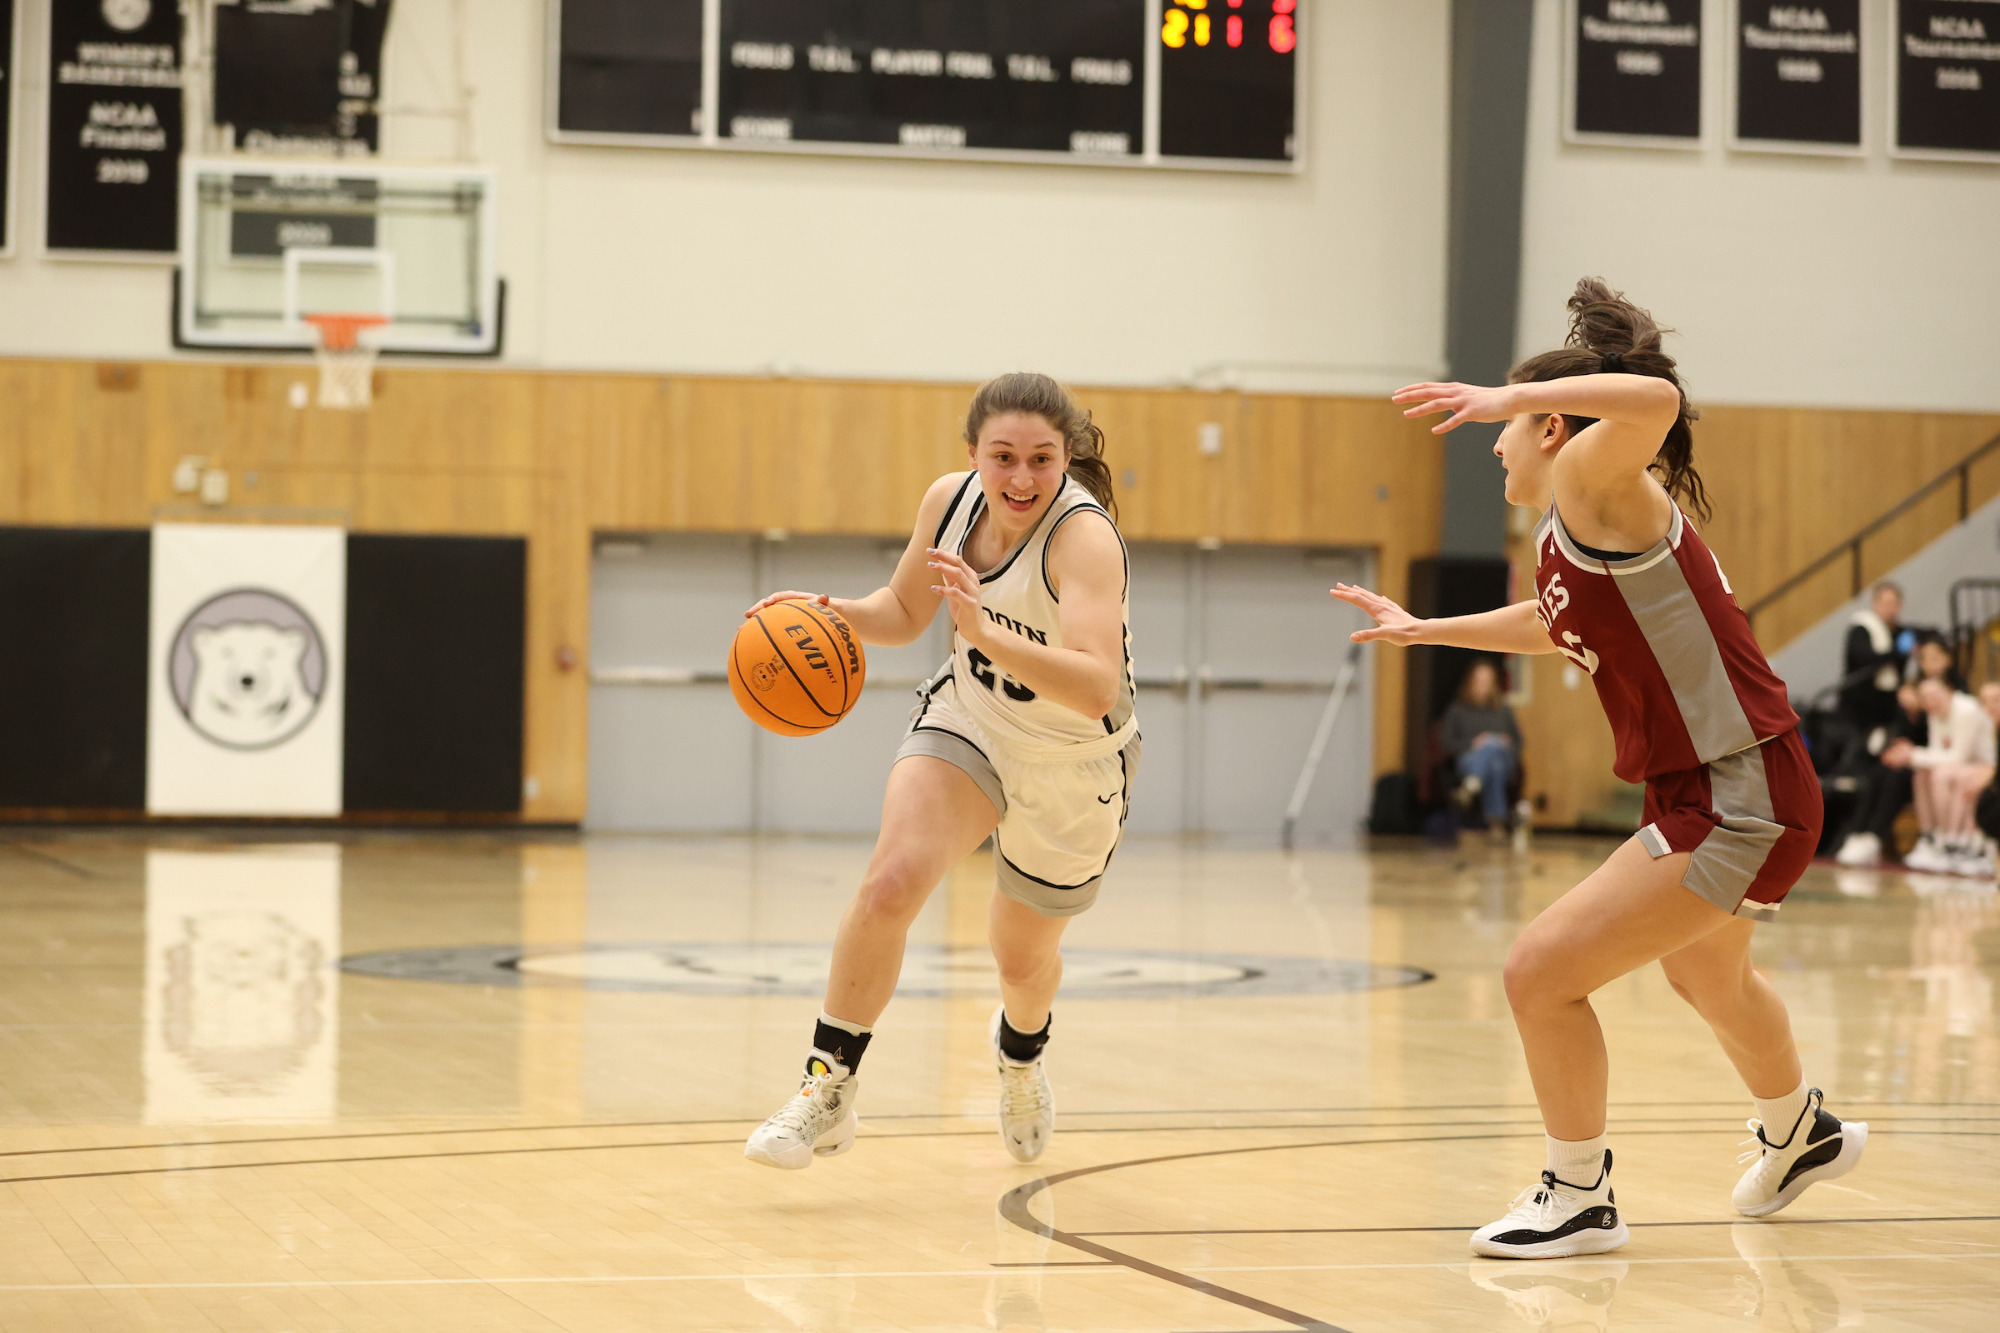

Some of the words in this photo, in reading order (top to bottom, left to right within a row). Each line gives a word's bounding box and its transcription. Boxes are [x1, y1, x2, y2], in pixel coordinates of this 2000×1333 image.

[1769, 5, 1828, 30] NCAA
[1930, 16, 1985, 38] NCAA
[731, 41, 795, 70] FOULS
[871, 48, 943, 76] PLAYER
[945, 51, 995, 79] FOUL
[1071, 57, 1132, 86] FOULS
[89, 101, 159, 127] NCAA
[80, 124, 167, 151] Finalist
[784, 624, 830, 670] EVO
[807, 599, 860, 676] Wilson
